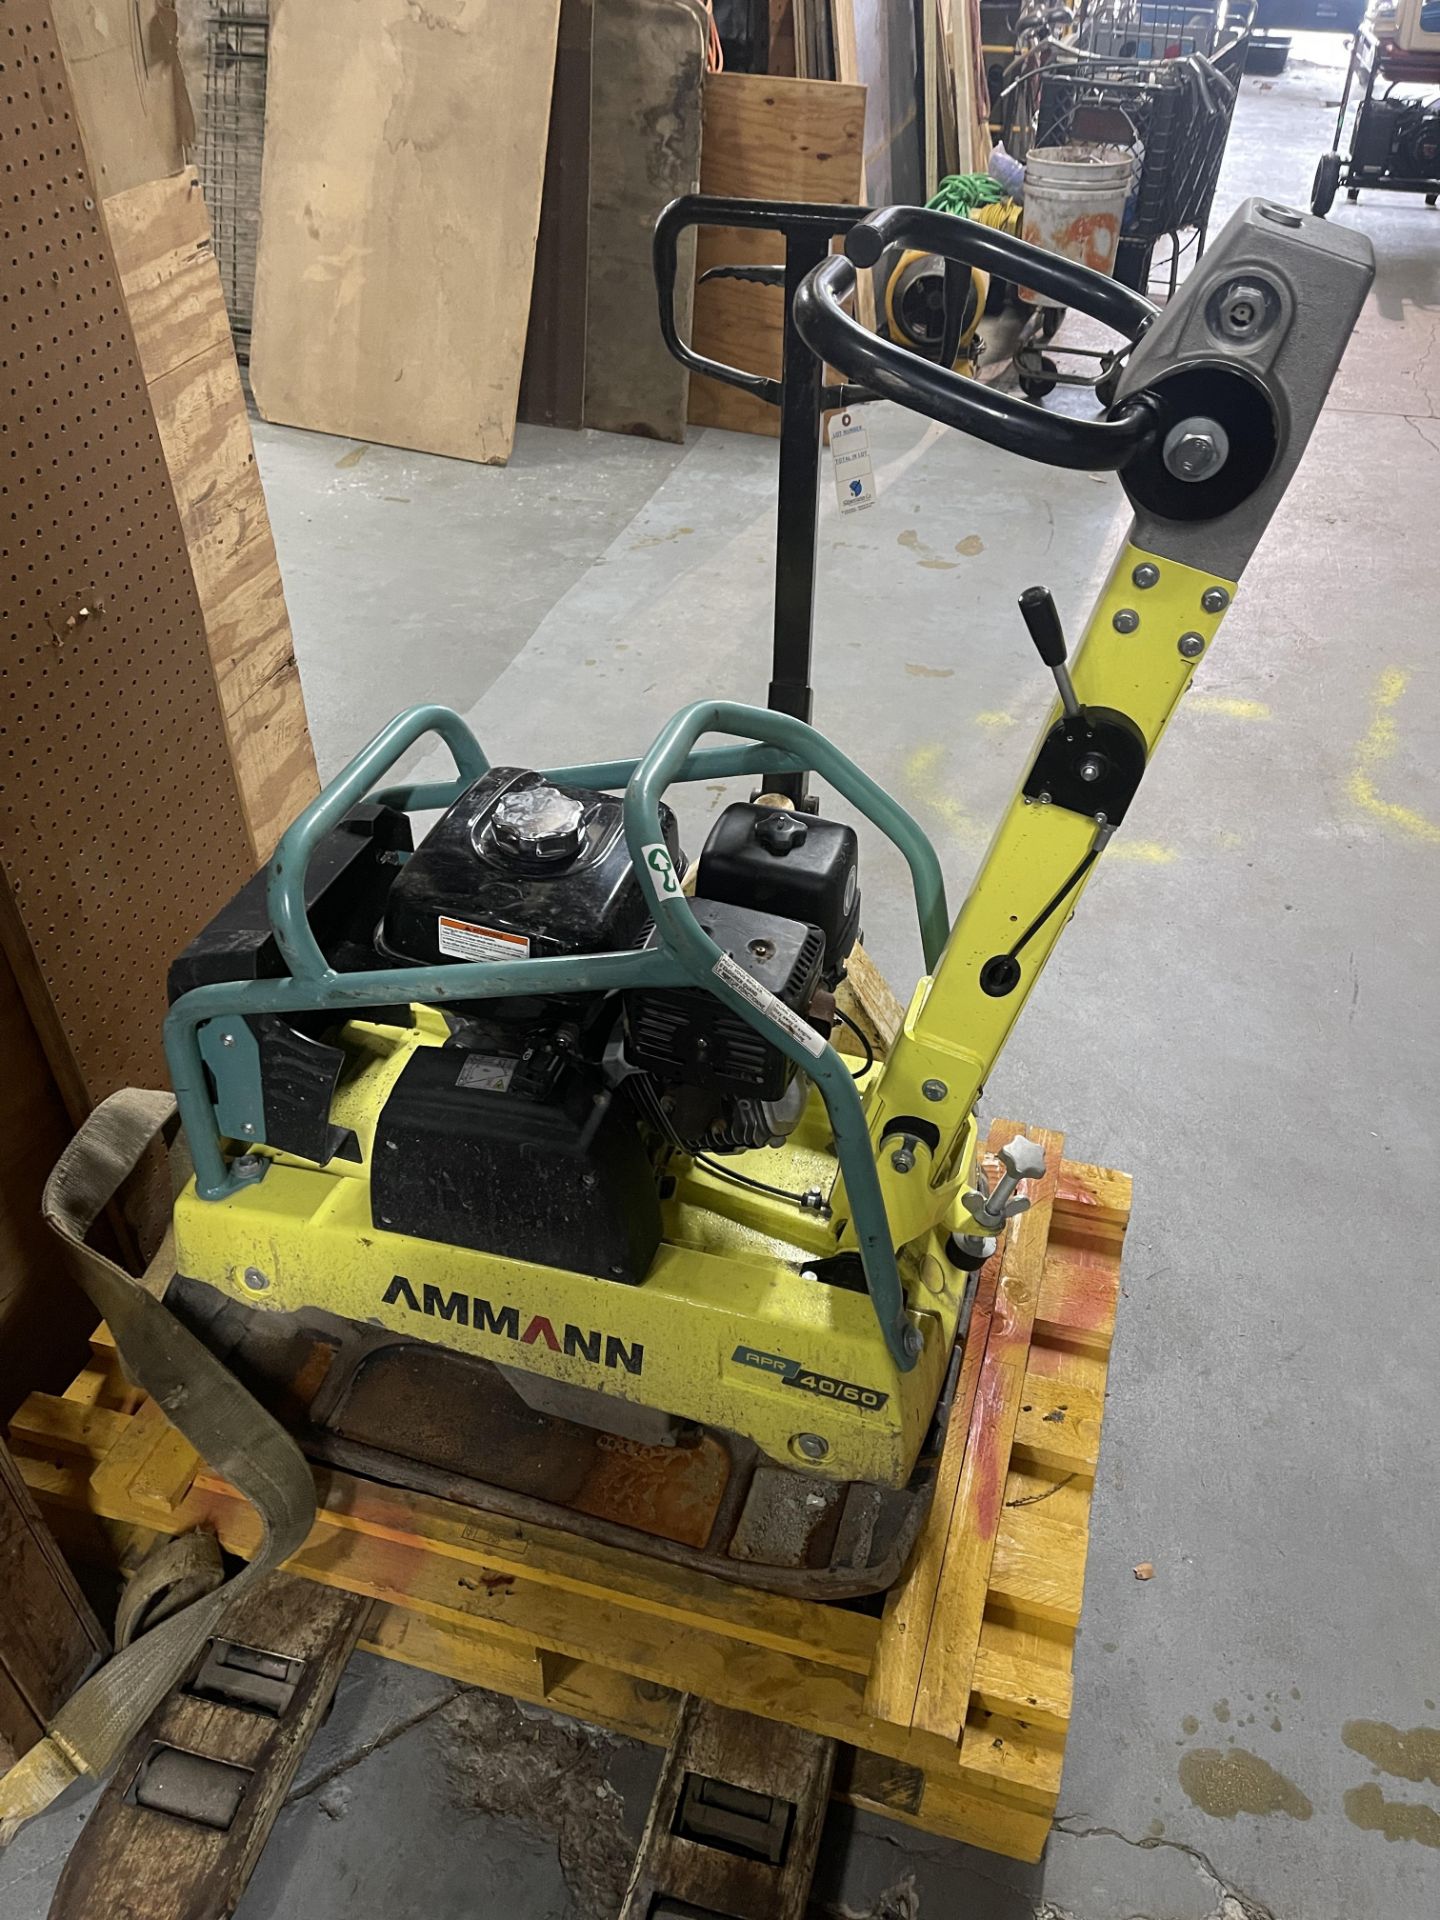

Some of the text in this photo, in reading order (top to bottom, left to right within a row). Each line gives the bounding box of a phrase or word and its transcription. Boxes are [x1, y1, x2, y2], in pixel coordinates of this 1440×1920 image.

[381, 1275, 644, 1376] AMMANN
[746, 1353, 787, 1371] APR
[800, 1375, 878, 1406] 40/60
